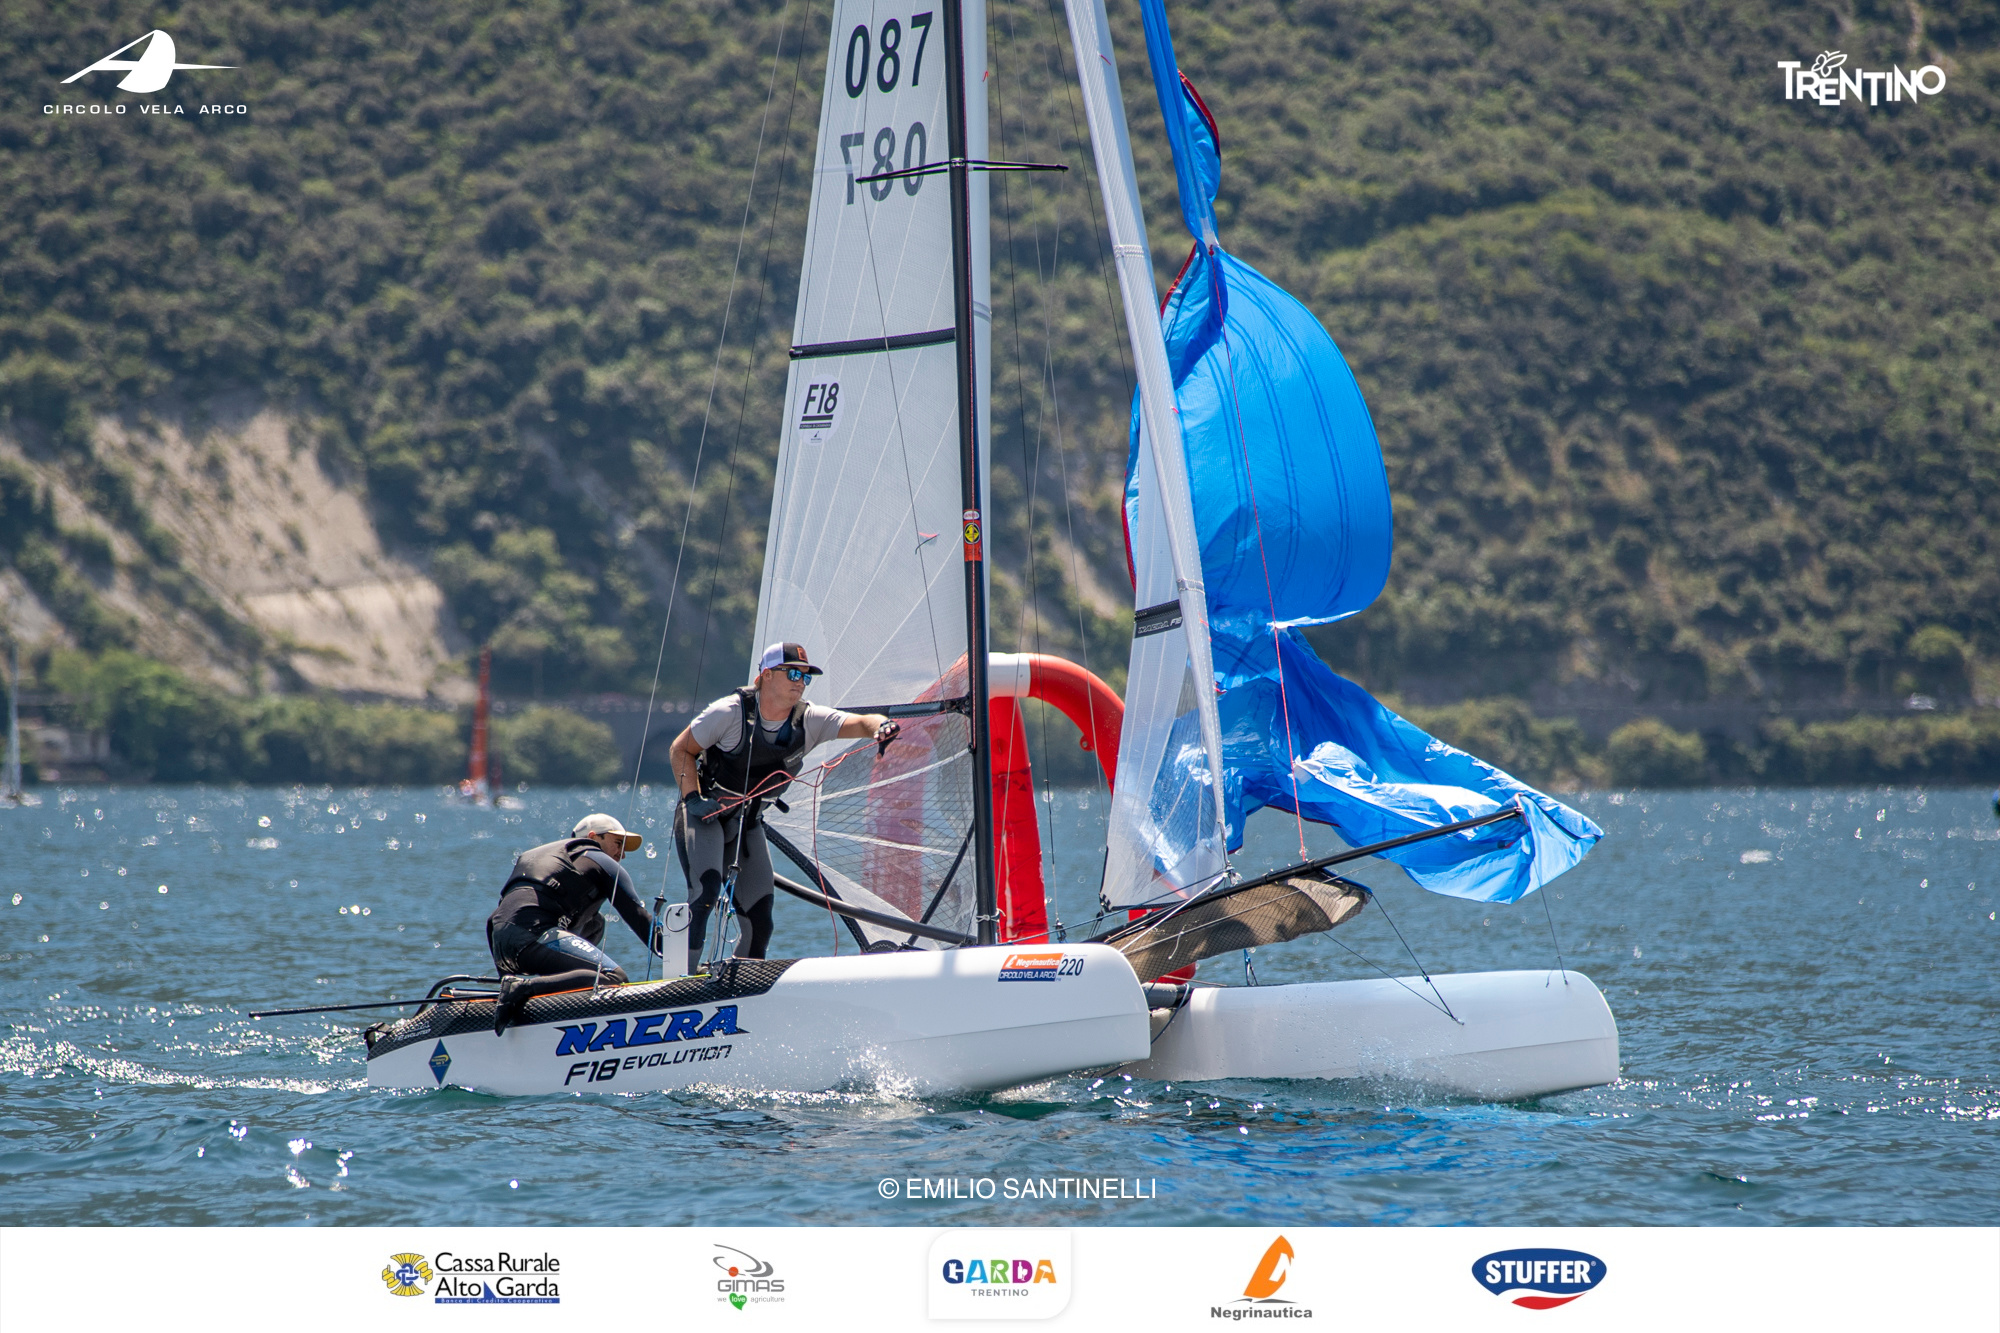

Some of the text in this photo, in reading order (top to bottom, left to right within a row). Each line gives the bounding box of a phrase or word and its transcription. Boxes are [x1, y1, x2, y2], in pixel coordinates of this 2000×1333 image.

[845, 11, 933, 99] 087
[803, 382, 839, 414] F18
[999, 971, 1023, 979] CIRCOLO
[1023, 971, 1040, 979] VELA
[1039, 971, 1057, 979] ARCO
[1016, 958, 1060, 968] Negrinautica
[1058, 958, 1084, 976] 220
[553, 1004, 750, 1057] NACRA
[564, 1044, 733, 1086] F18 EVOLUTION
